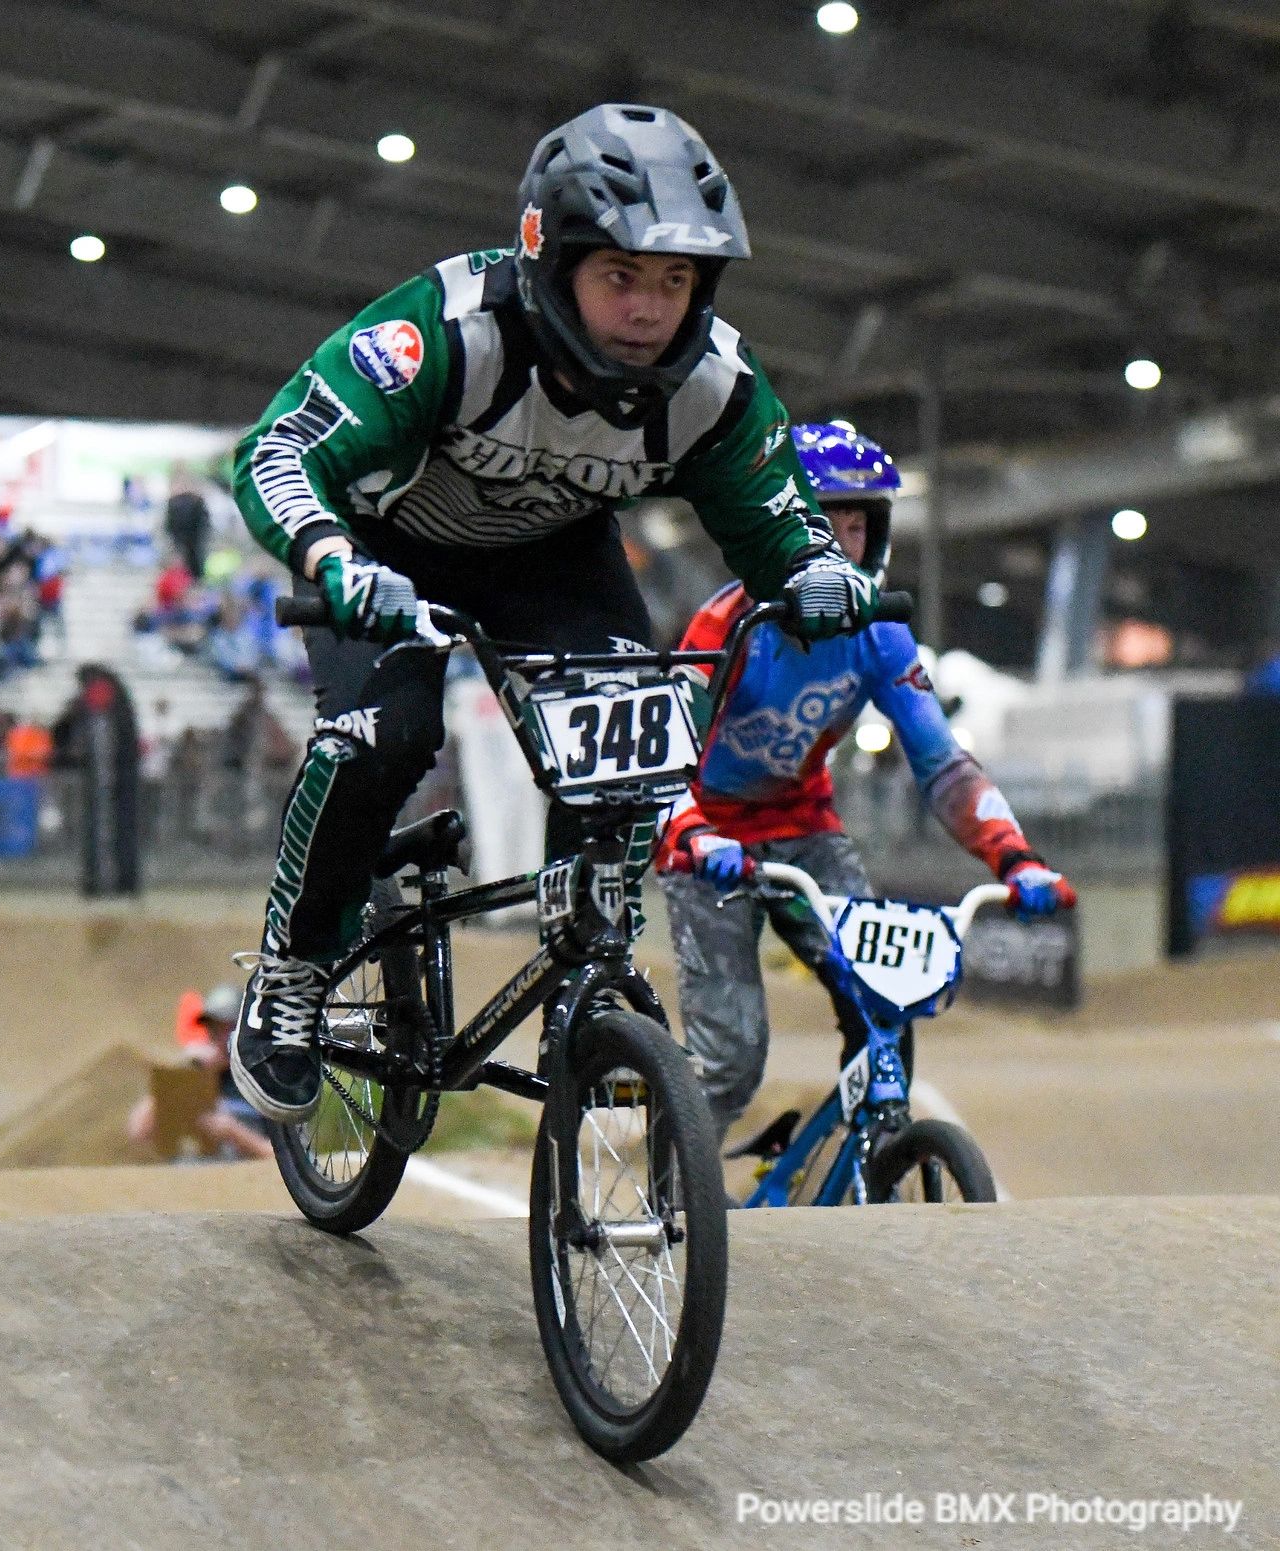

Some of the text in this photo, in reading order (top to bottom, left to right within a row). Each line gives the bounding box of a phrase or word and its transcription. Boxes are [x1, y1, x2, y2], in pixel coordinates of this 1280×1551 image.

[642, 222, 733, 248] FLY
[566, 694, 672, 779] 348
[855, 920, 934, 974] 854
